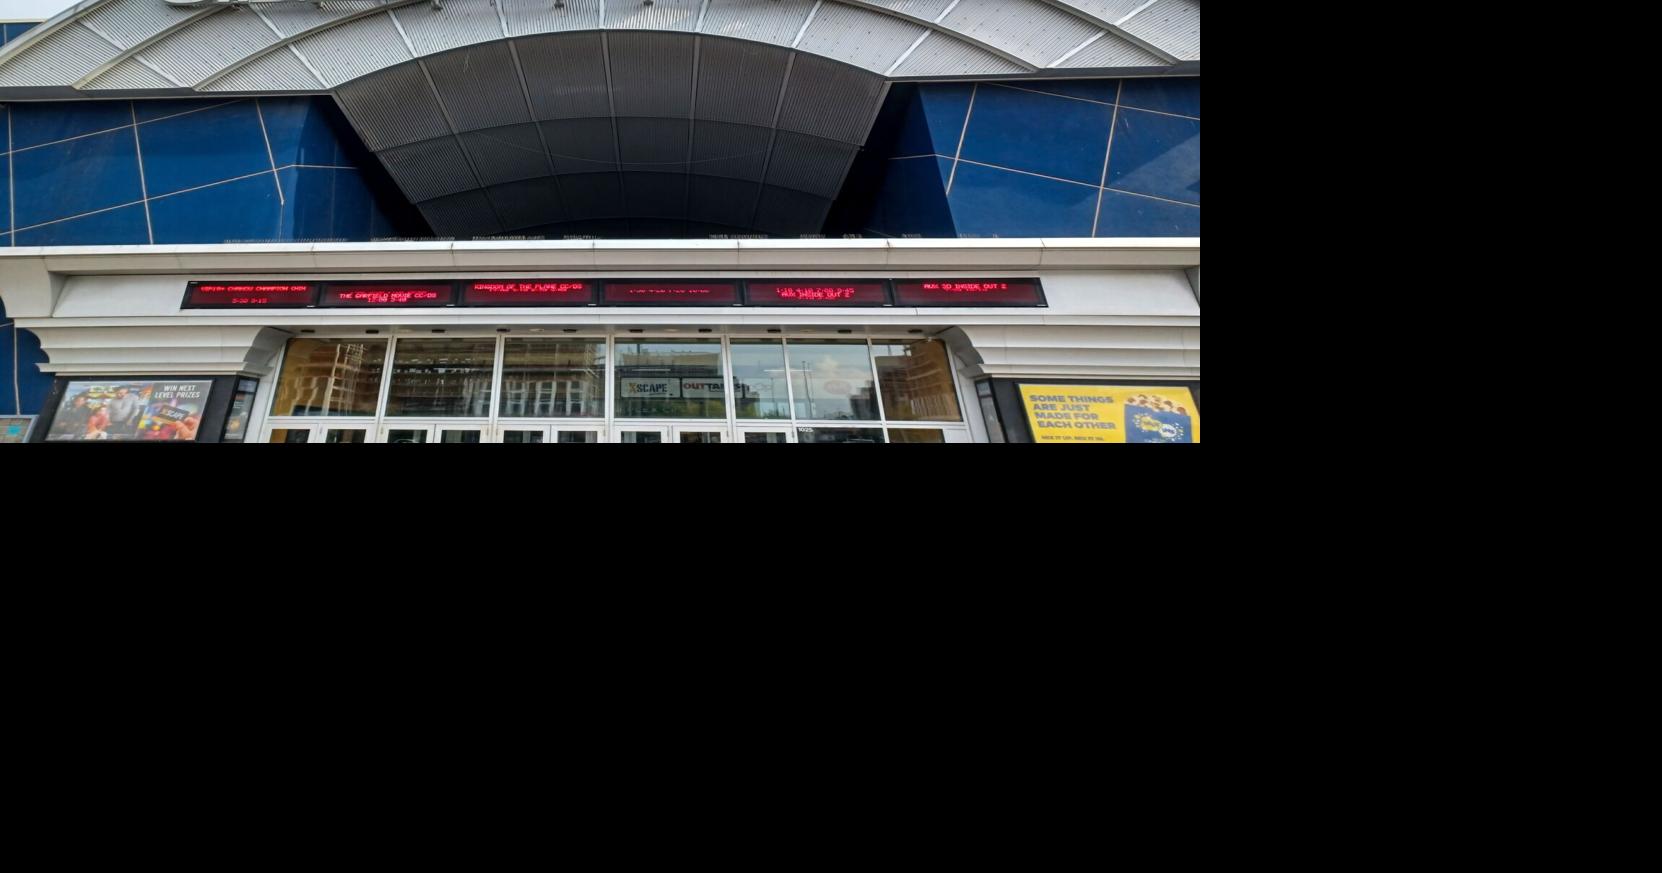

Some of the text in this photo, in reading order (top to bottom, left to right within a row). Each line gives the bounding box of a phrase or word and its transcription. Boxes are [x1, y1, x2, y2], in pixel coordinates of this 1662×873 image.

[340, 291, 353, 299] THE
[628, 382, 668, 393] XSCAPE
[154, 391, 201, 399] LEVEL PRIZES
[1029, 395, 1114, 404] SOME THINGS
[1033, 403, 1090, 412] ARE JUST
[1034, 412, 1099, 421] MADE FOR
[1037, 420, 1116, 430] EACH OTHER
